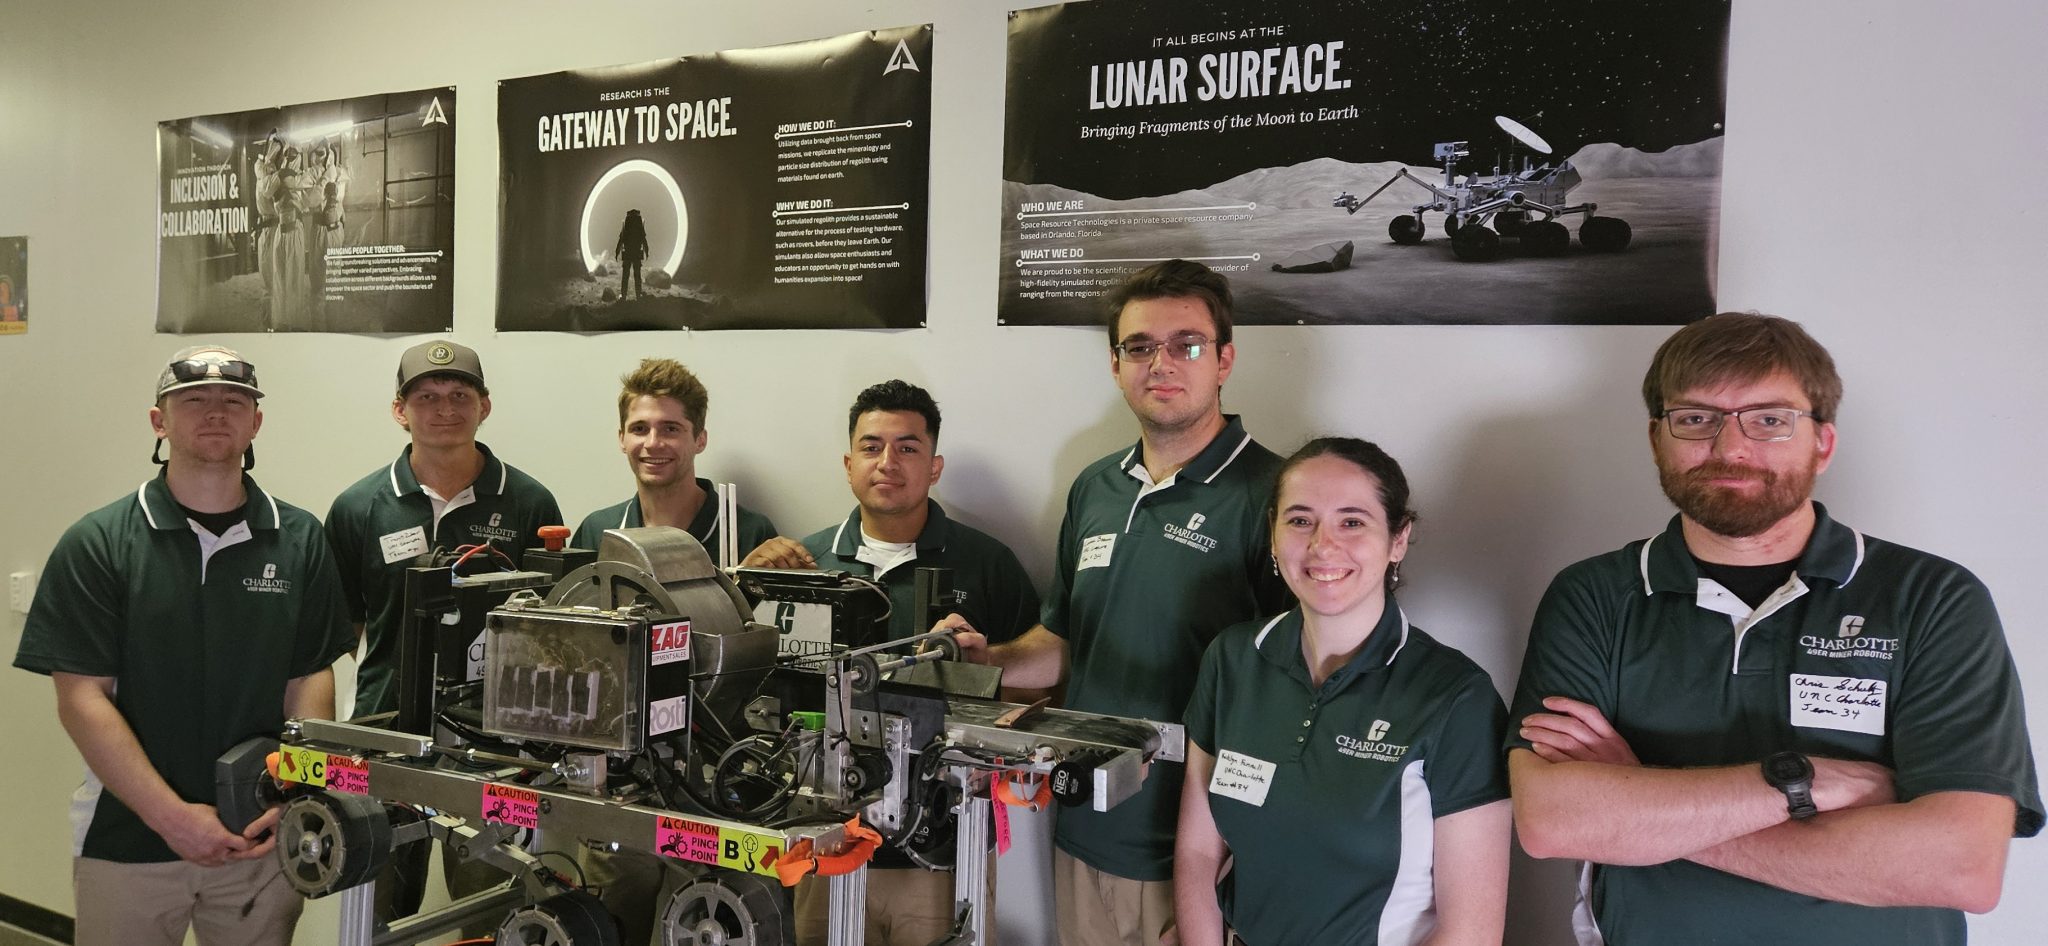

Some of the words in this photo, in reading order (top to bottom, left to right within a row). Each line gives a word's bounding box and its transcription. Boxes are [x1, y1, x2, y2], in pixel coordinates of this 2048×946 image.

[1153, 38, 1163, 48] IT
[1166, 35, 1186, 46] ALL
[1191, 31, 1236, 44] BEGINS
[1240, 30, 1257, 39] AT
[1260, 26, 1283, 36] THE
[1090, 57, 1188, 110] LUNAR
[1197, 41, 1351, 101] SURFACE.
[601, 90, 641, 101] RESEARCH
[645, 89, 651, 97] IS
[654, 87, 670, 96] THE
[538, 108, 629, 152] GATEWAY
[634, 105, 660, 144] TO
[665, 97, 737, 141] SPACE.
[778, 123, 797, 133] HOW
[799, 122, 812, 131] WE
[814, 121, 824, 130] DO
[1081, 123, 1135, 140] Bringing
[1139, 119, 1210, 137] Fragments
[1213, 115, 1230, 133] of
[1231, 114, 1251, 128] the
[1256, 112, 1295, 126] Moon
[1300, 111, 1314, 123] to
[1318, 105, 1359, 121] Earth
[814, 137, 835, 145] brought
[813, 149, 836, 157] replicate
[847, 145, 879, 153] mineralogy
[778, 162, 798, 172] particle
[810, 160, 841, 168] distribution
[849, 157, 871, 166] regolith
[872, 156, 888, 164] using
[804, 173, 819, 181] found
[171, 174, 226, 203] INCLUSION
[229, 173, 239, 199] &
[776, 202, 795, 211] WHY
[796, 201, 809, 210] WE
[811, 200, 822, 209] DO
[1021, 203, 1044, 212] WHO
[1047, 201, 1062, 211] WE
[1064, 200, 1083, 210] ARE
[162, 207, 248, 237] COLLABORATION
[787, 217, 812, 225] simulated
[814, 216, 834, 224] regolith
[836, 214, 859, 223] provides
[865, 212, 898, 220] sustainable
[1021, 222, 1040, 230] Space
[1041, 220, 1071, 228] Resource
[1073, 218, 1118, 226] Technologies
[1161, 216, 1182, 224] space
[1219, 213, 1253, 221] company
[776, 229, 804, 237] alternative
[824, 227, 845, 236] process
[353, 246, 373, 255] PEOPLE
[814, 251, 829, 259] allow
[830, 251, 846, 259] space
[847, 249, 880, 257] enthusiasts
[1021, 249, 1050, 259] WHAT
[1052, 249, 1067, 258] WE
[1070, 248, 1083, 257] DO
[775, 264, 801, 272] educators
[810, 263, 841, 271] opportunity
[849, 262, 858, 270] get
[1044, 268, 1063, 276] proud
[1096, 266, 1127, 274] scientific
[805, 276, 832, 284] expansion
[845, 274, 863, 282] space!
[1020, 279, 1060, 288] high-fidelity
[1020, 291, 1044, 299] ranging
[1075, 289, 1100, 298] regions
[470, 525, 517, 538] CHARLOTTE
[1164, 523, 1217, 548] CHARLOTTE
[652, 625, 689, 652] ZAG
[1800, 635, 1900, 651] CHARLOTTE
[1807, 648, 1827, 657] 49ER
[1829, 650, 1852, 658] MINER
[1854, 650, 1893, 660] ROBOTICS
[1837, 694, 1881, 707] Charlotte
[1840, 709, 1860, 719] 34
[1336, 735, 1408, 755] CHARLOTTE
[313, 762, 323, 778] C
[348, 772, 368, 782] PINCH
[1055, 770, 1066, 795] NEO
[347, 783, 368, 793] POINT
[498, 787, 538, 802] CAUTION
[514, 803, 538, 815] PINCH
[513, 815, 537, 827] POINT
[674, 819, 719, 836] CAUTION
[692, 837, 719, 850] PINCH
[724, 839, 739, 860] B
[691, 850, 718, 862] POINT
